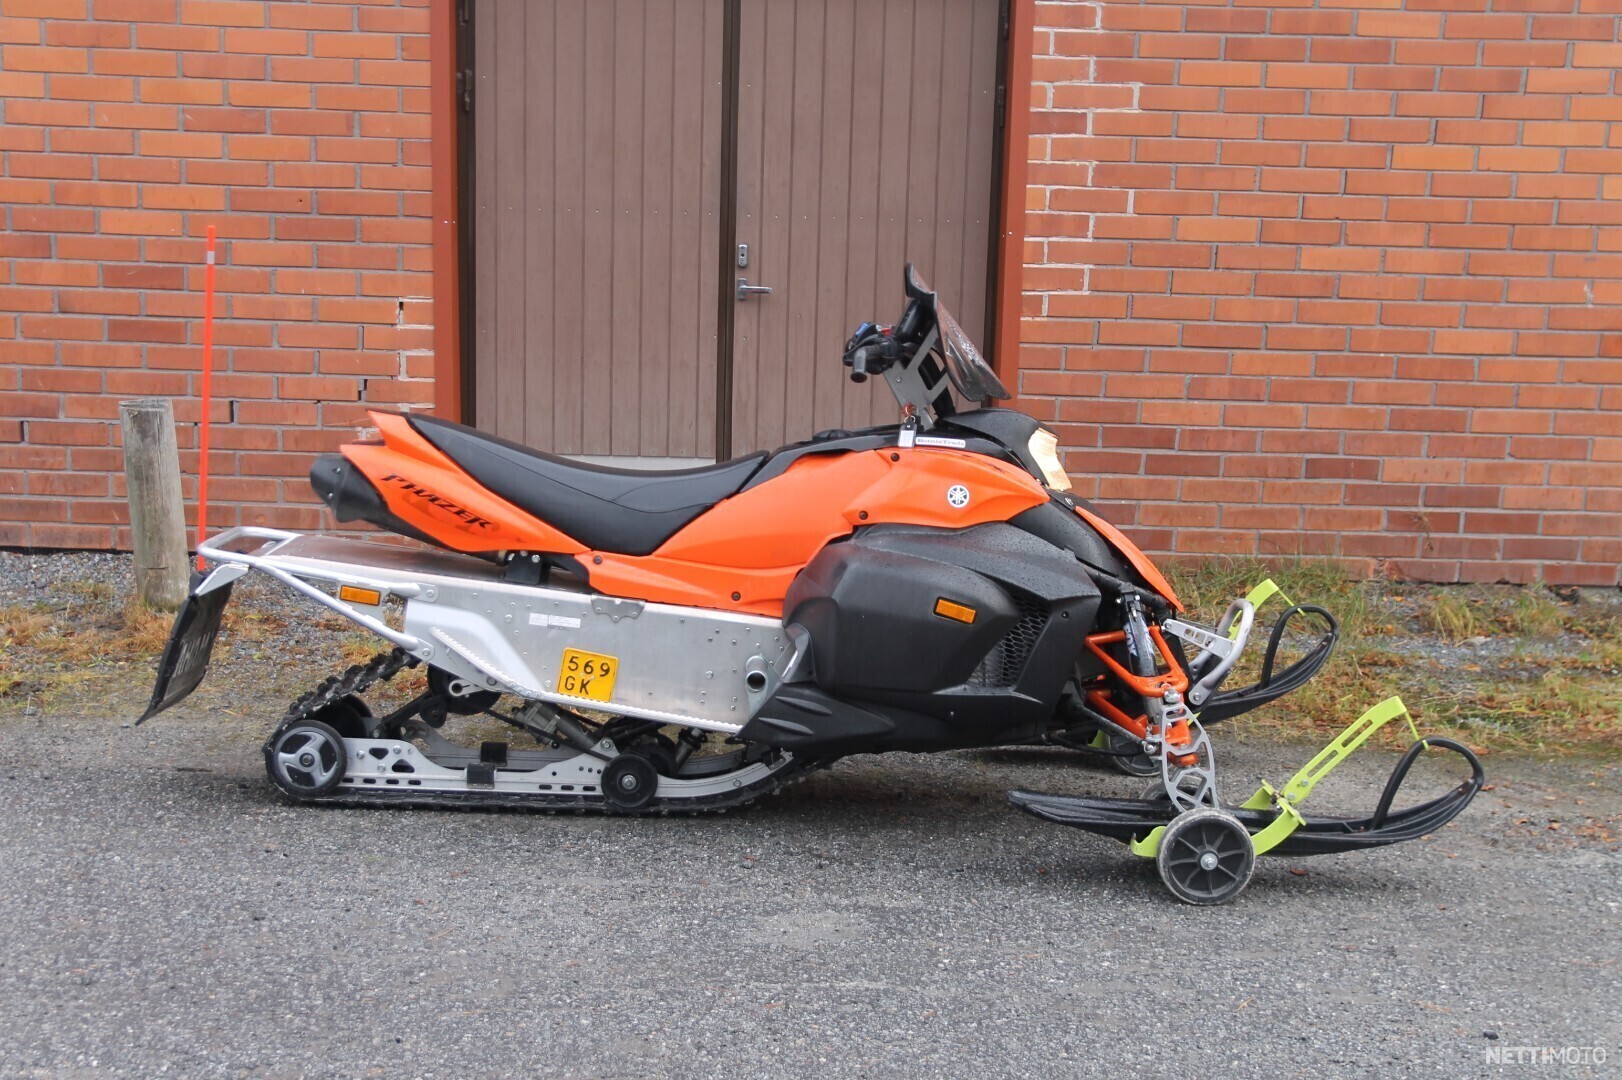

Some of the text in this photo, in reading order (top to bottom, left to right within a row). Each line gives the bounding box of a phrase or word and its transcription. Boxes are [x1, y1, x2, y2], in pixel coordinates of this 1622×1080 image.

[381, 474, 493, 529] PHAZER
[568, 655, 611, 677] 569
[564, 675, 591, 695] GK
